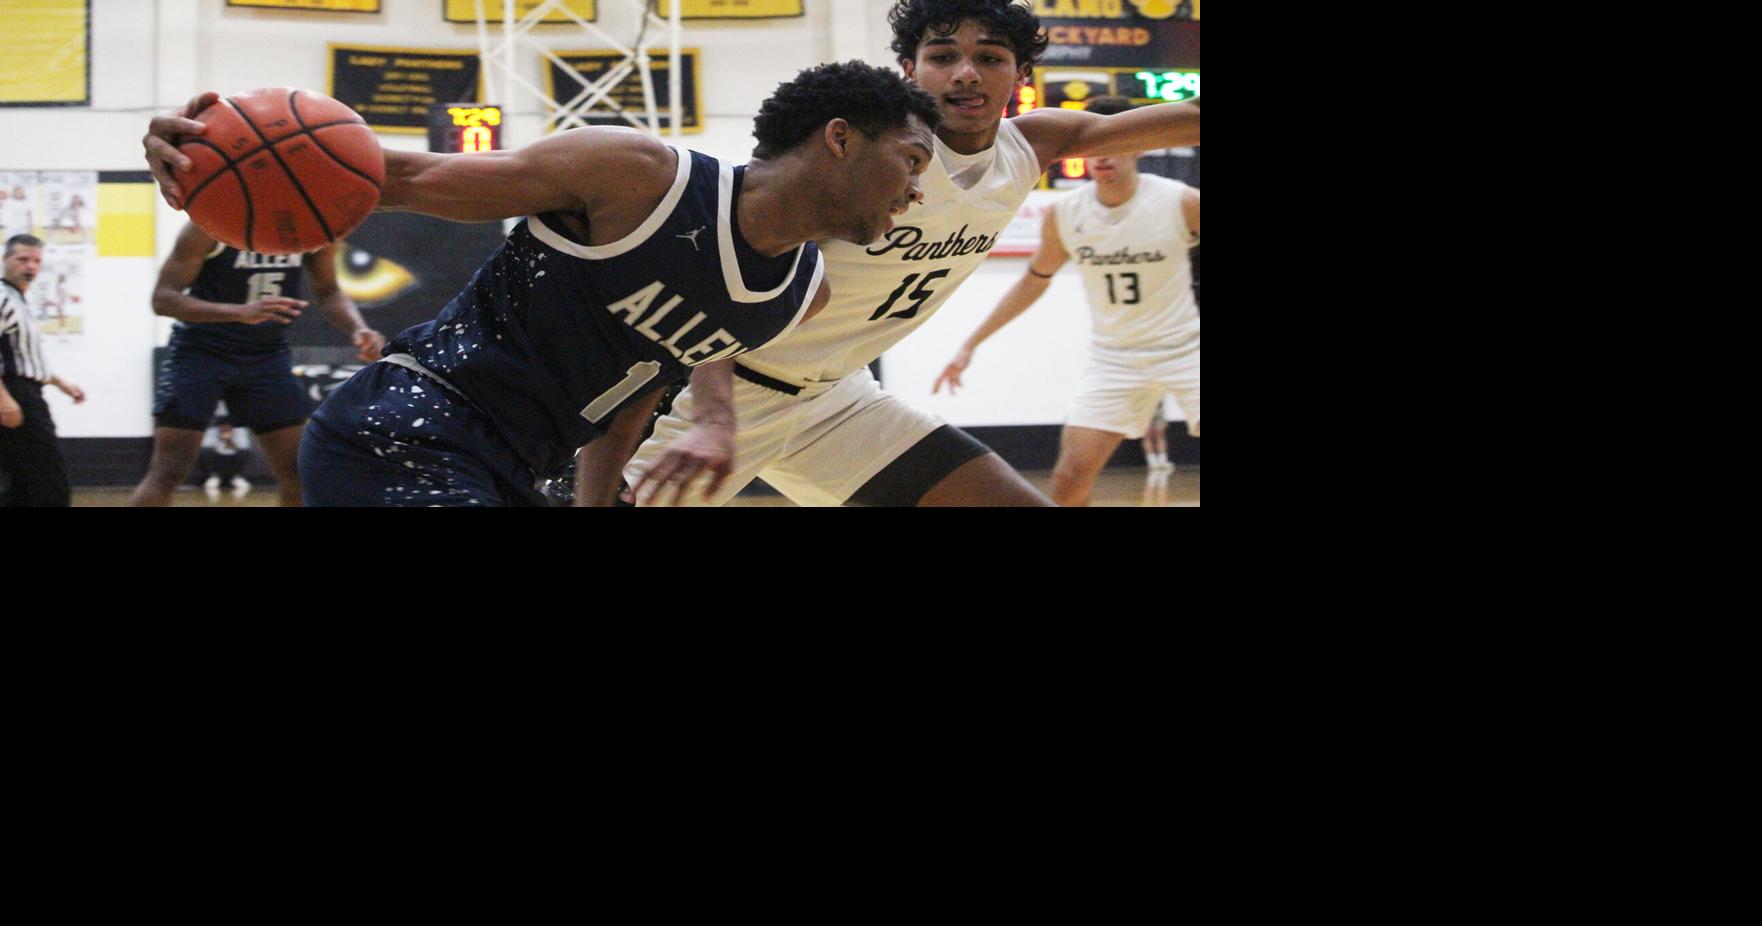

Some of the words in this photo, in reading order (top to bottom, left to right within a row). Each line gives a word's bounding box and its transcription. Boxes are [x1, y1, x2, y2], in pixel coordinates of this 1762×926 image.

[866, 224, 998, 261] Panthers
[1076, 246, 1167, 265] Panthers
[868, 268, 951, 321] 15
[1104, 272, 1140, 305] 13
[580, 360, 661, 424] 1
